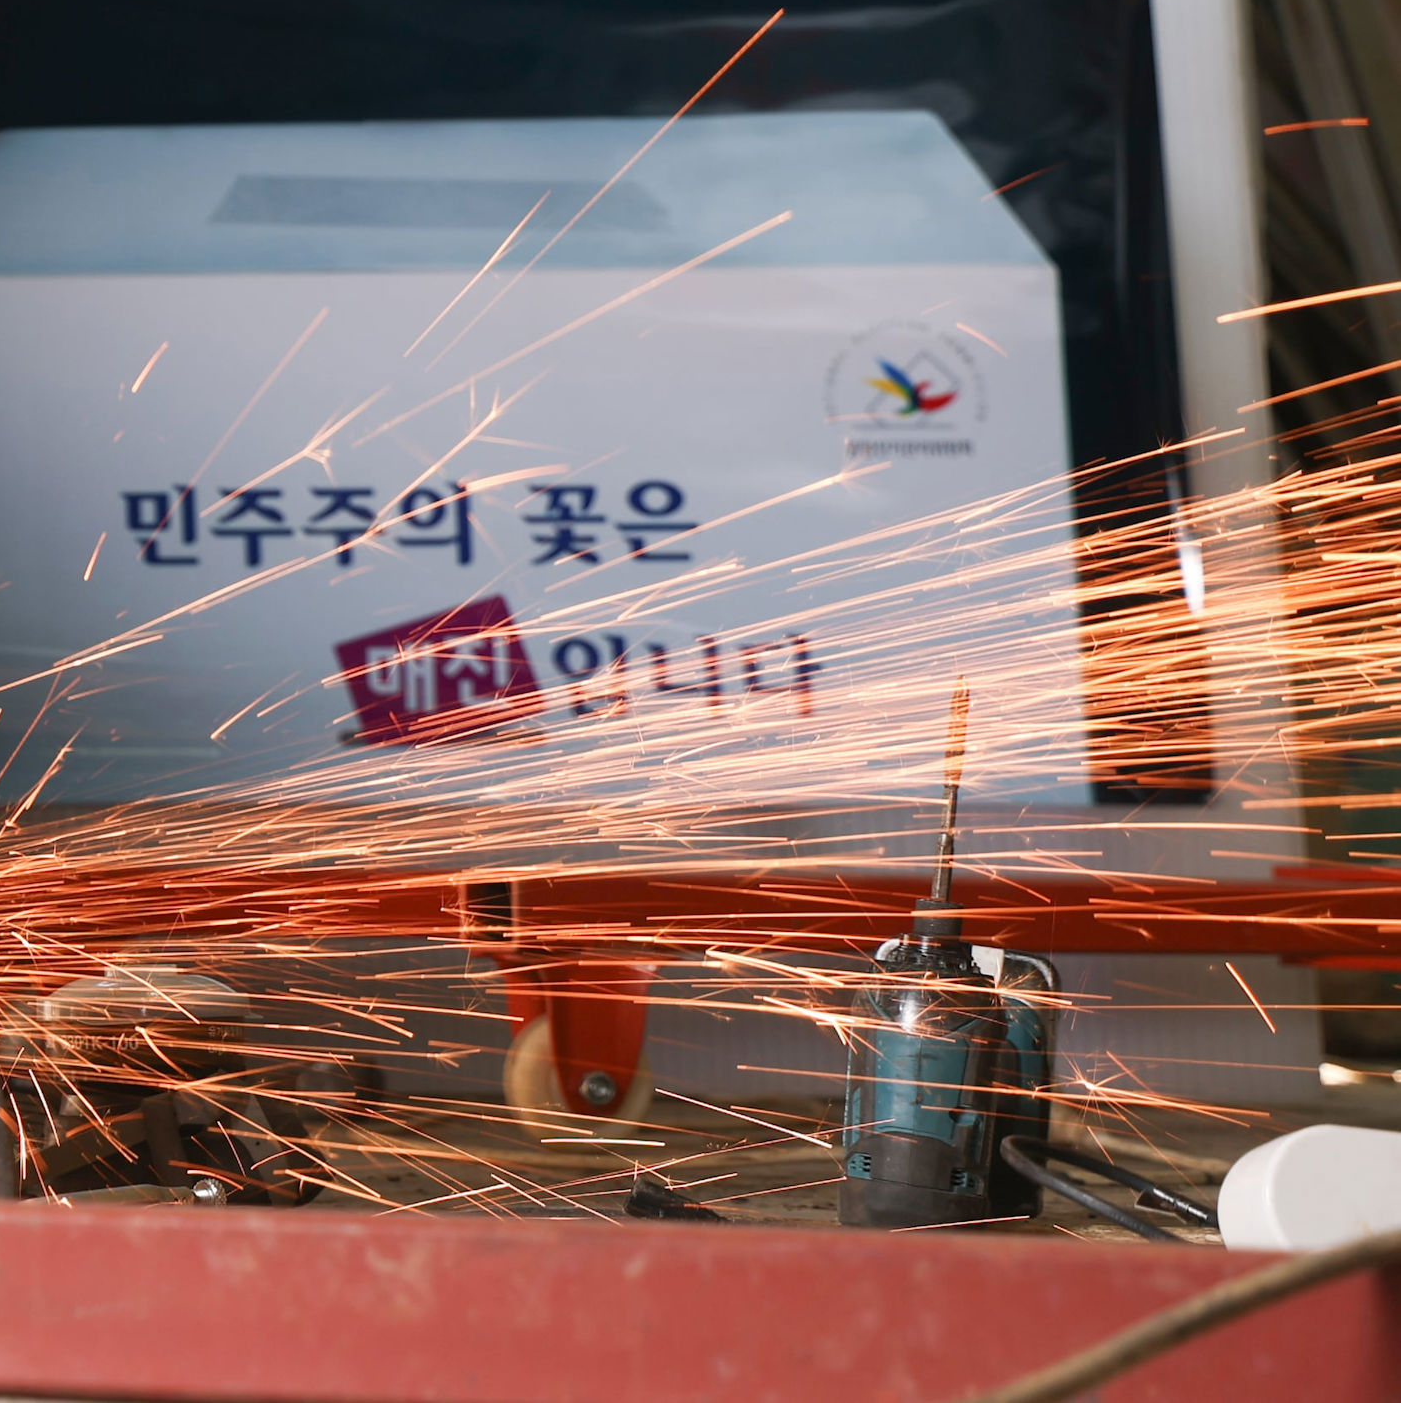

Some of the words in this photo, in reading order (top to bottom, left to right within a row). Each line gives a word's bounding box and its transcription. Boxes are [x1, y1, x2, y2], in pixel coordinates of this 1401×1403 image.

[122, 478, 473, 568] 민주주의
[522, 477, 698, 566] 꽃은
[550, 630, 821, 719] 입니다
